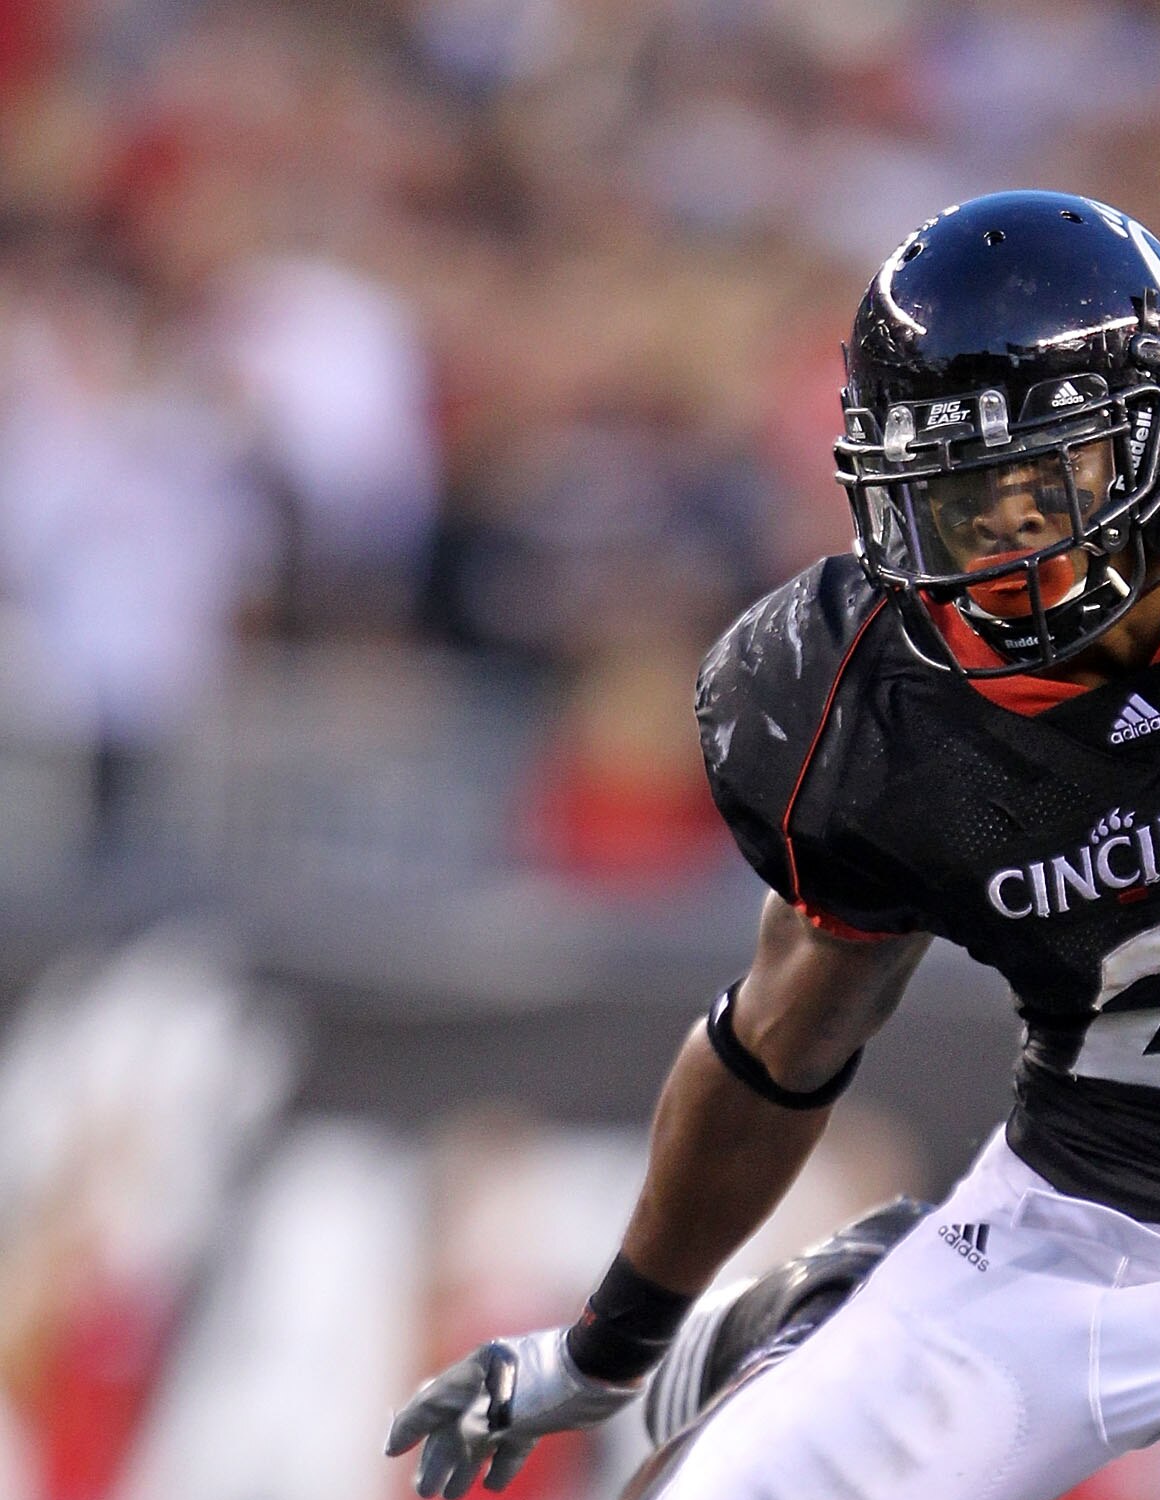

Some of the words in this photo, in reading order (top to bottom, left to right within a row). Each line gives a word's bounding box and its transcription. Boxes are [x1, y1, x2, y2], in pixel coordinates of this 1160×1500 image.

[930, 401, 961, 416] BIG
[1052, 394, 1085, 408] adidas
[927, 409, 971, 426] EAST
[1115, 407, 1153, 491] Rddell.
[938, 1224, 990, 1273] adidas
